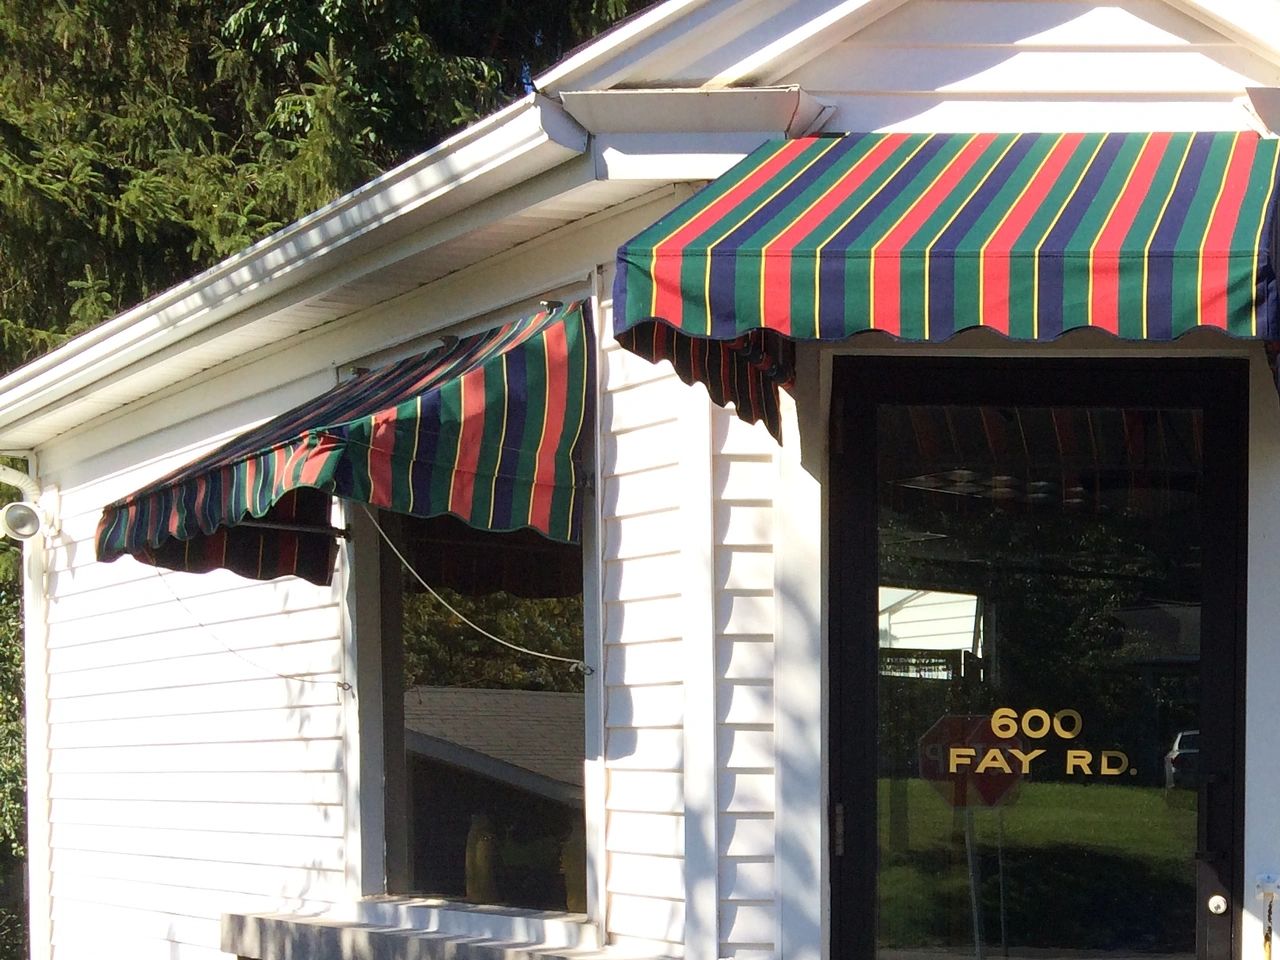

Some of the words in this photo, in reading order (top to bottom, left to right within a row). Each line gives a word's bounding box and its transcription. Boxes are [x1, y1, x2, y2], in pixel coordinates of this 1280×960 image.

[990, 707, 1083, 740] 600
[949, 747, 1047, 775] FAY
[1066, 749, 1138, 776] RD.
